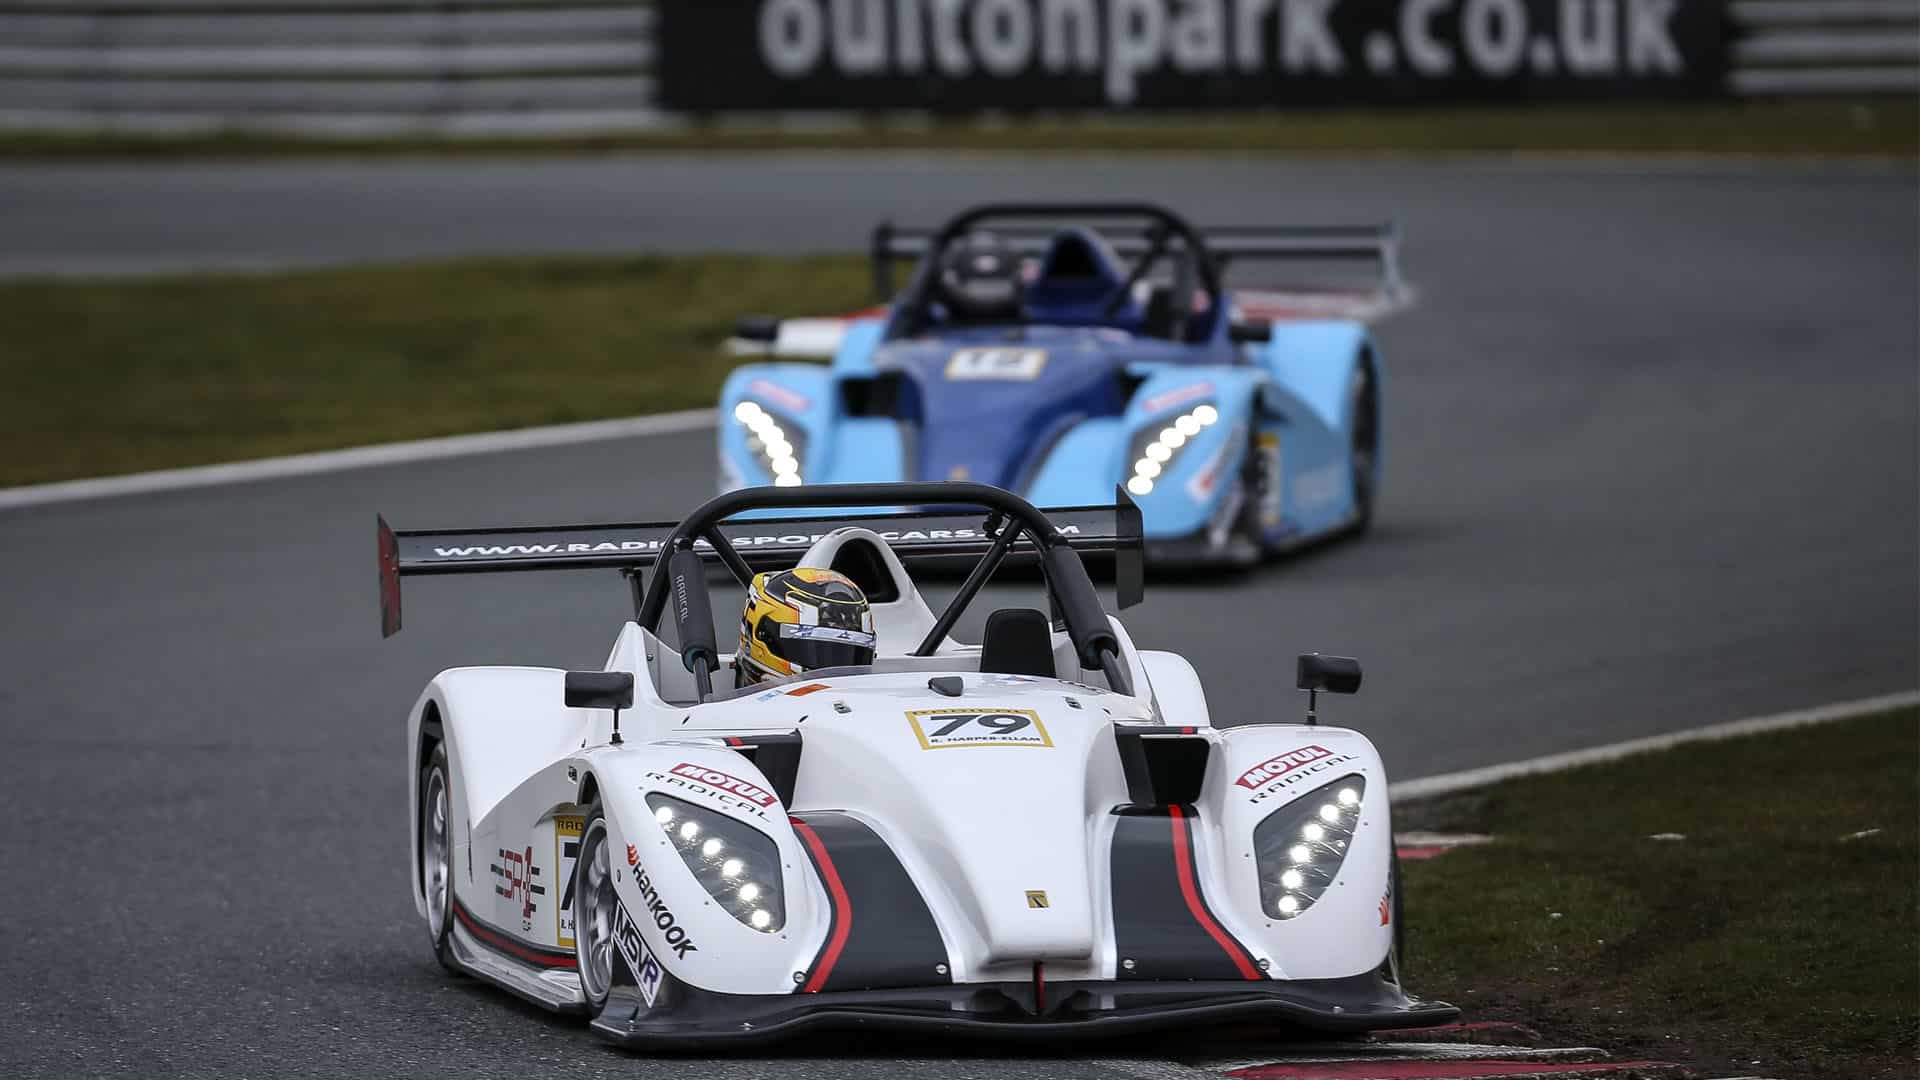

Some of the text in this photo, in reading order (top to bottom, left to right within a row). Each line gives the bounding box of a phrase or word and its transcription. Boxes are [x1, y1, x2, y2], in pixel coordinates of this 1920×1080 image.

[676, 575, 688, 623] RADICAL
[928, 714, 1031, 737] 79
[678, 765, 772, 806] MOTUL
[1243, 746, 1327, 788] MOTUL
[1249, 754, 1360, 804] RADICAL
[645, 772, 772, 823] RADICAL
[615, 917, 659, 989] MSVR
